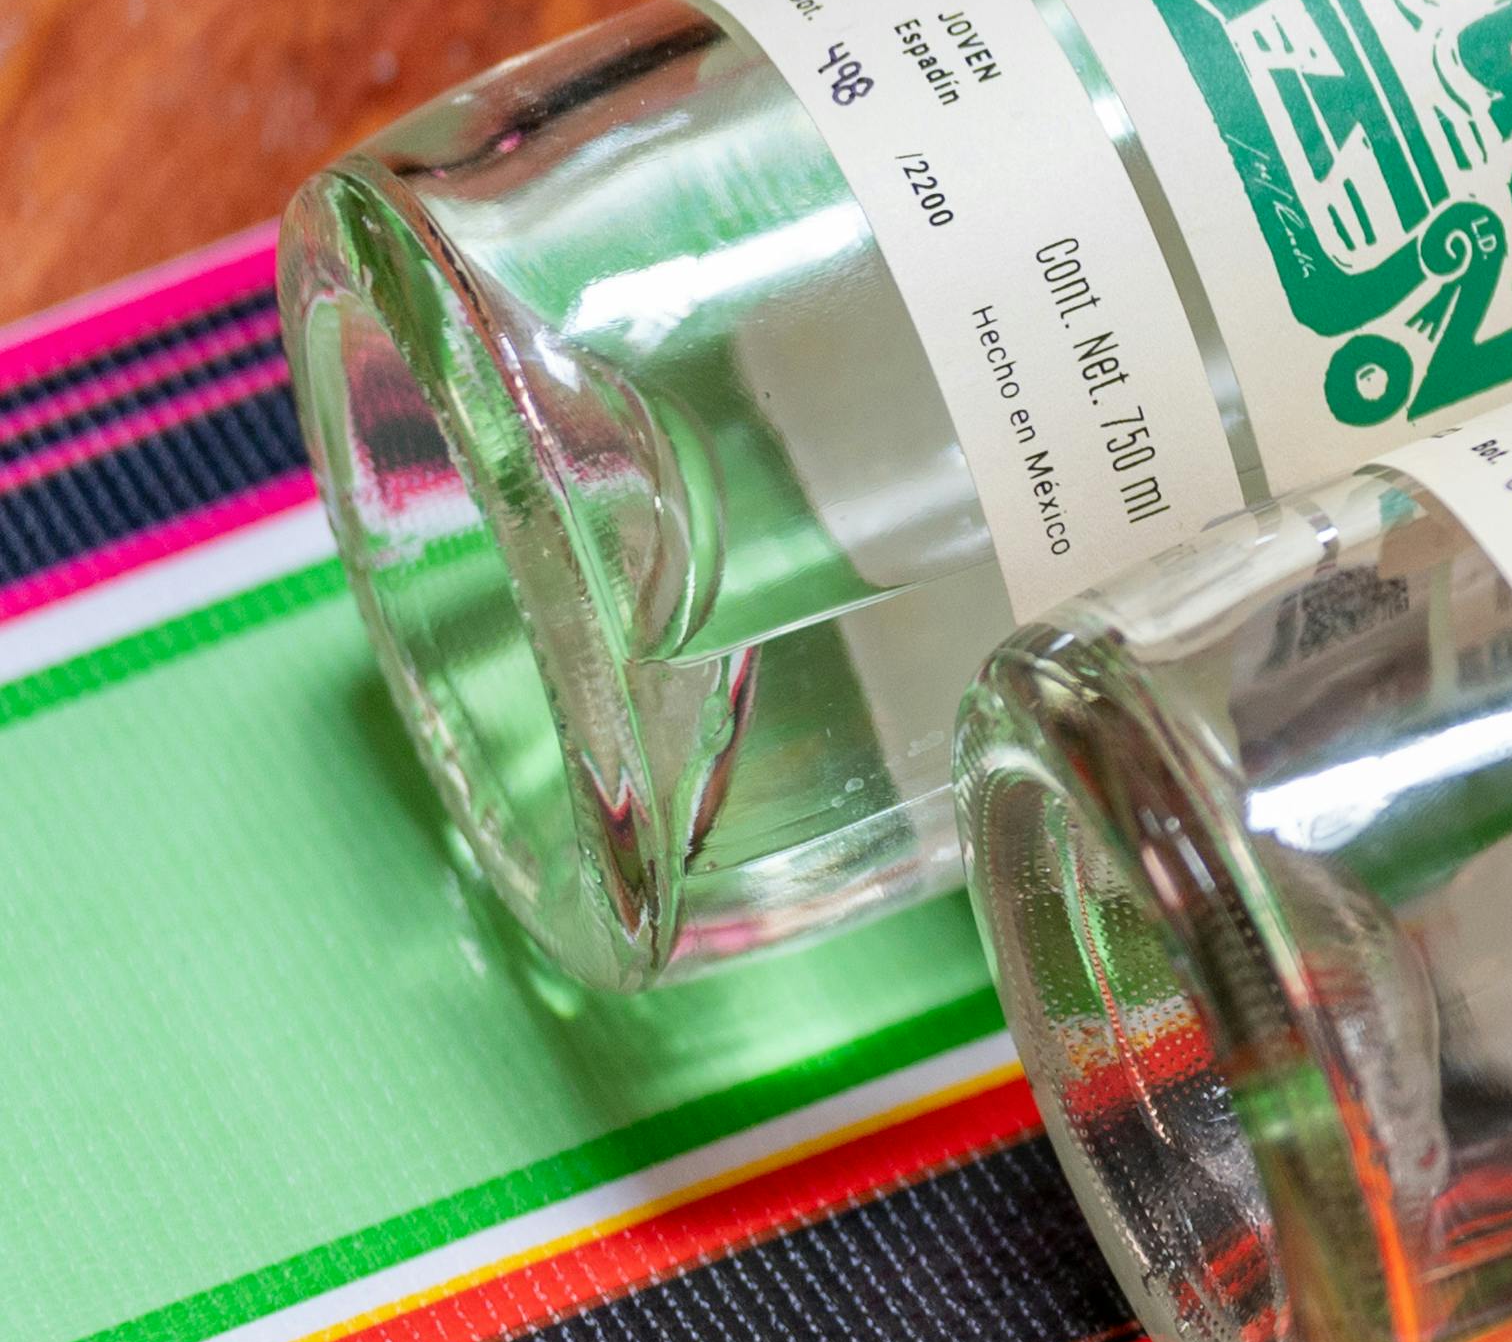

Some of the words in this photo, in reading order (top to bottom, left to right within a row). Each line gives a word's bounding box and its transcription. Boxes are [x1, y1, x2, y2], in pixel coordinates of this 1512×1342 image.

[893, 18, 960, 106] Espadín
[937, 10, 1002, 84] JOVEN
[894, 152, 955, 228] /2200
[1035, 237, 1102, 330] Cont.
[971, 305, 1021, 400] Hecho
[1072, 330, 1130, 407] Net.
[1009, 407, 1038, 445] en
[1099, 404, 1157, 473] 750
[1023, 449, 1071, 556] México
[1119, 475, 1172, 525] ml
